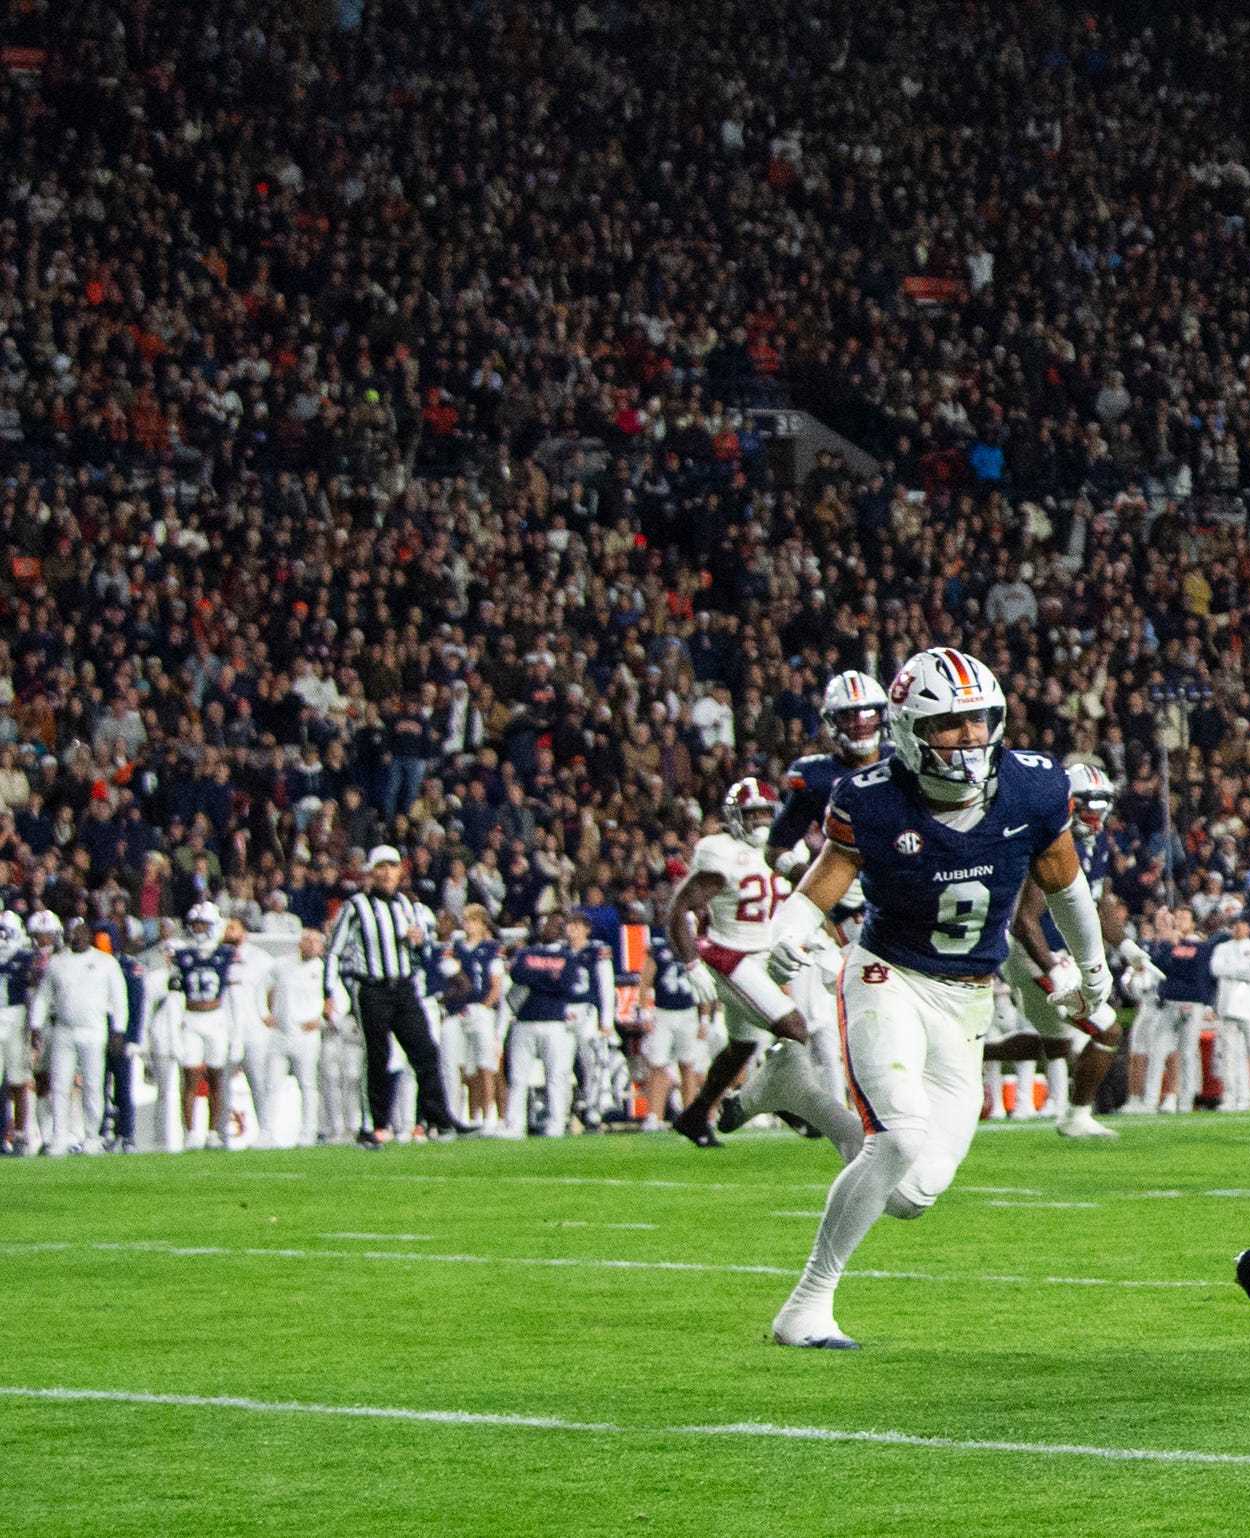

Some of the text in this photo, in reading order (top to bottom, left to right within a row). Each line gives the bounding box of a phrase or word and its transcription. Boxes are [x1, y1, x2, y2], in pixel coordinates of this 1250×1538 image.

[899, 832, 921, 852] SEC
[932, 864, 994, 882] AUBURN
[930, 880, 991, 954] 9
